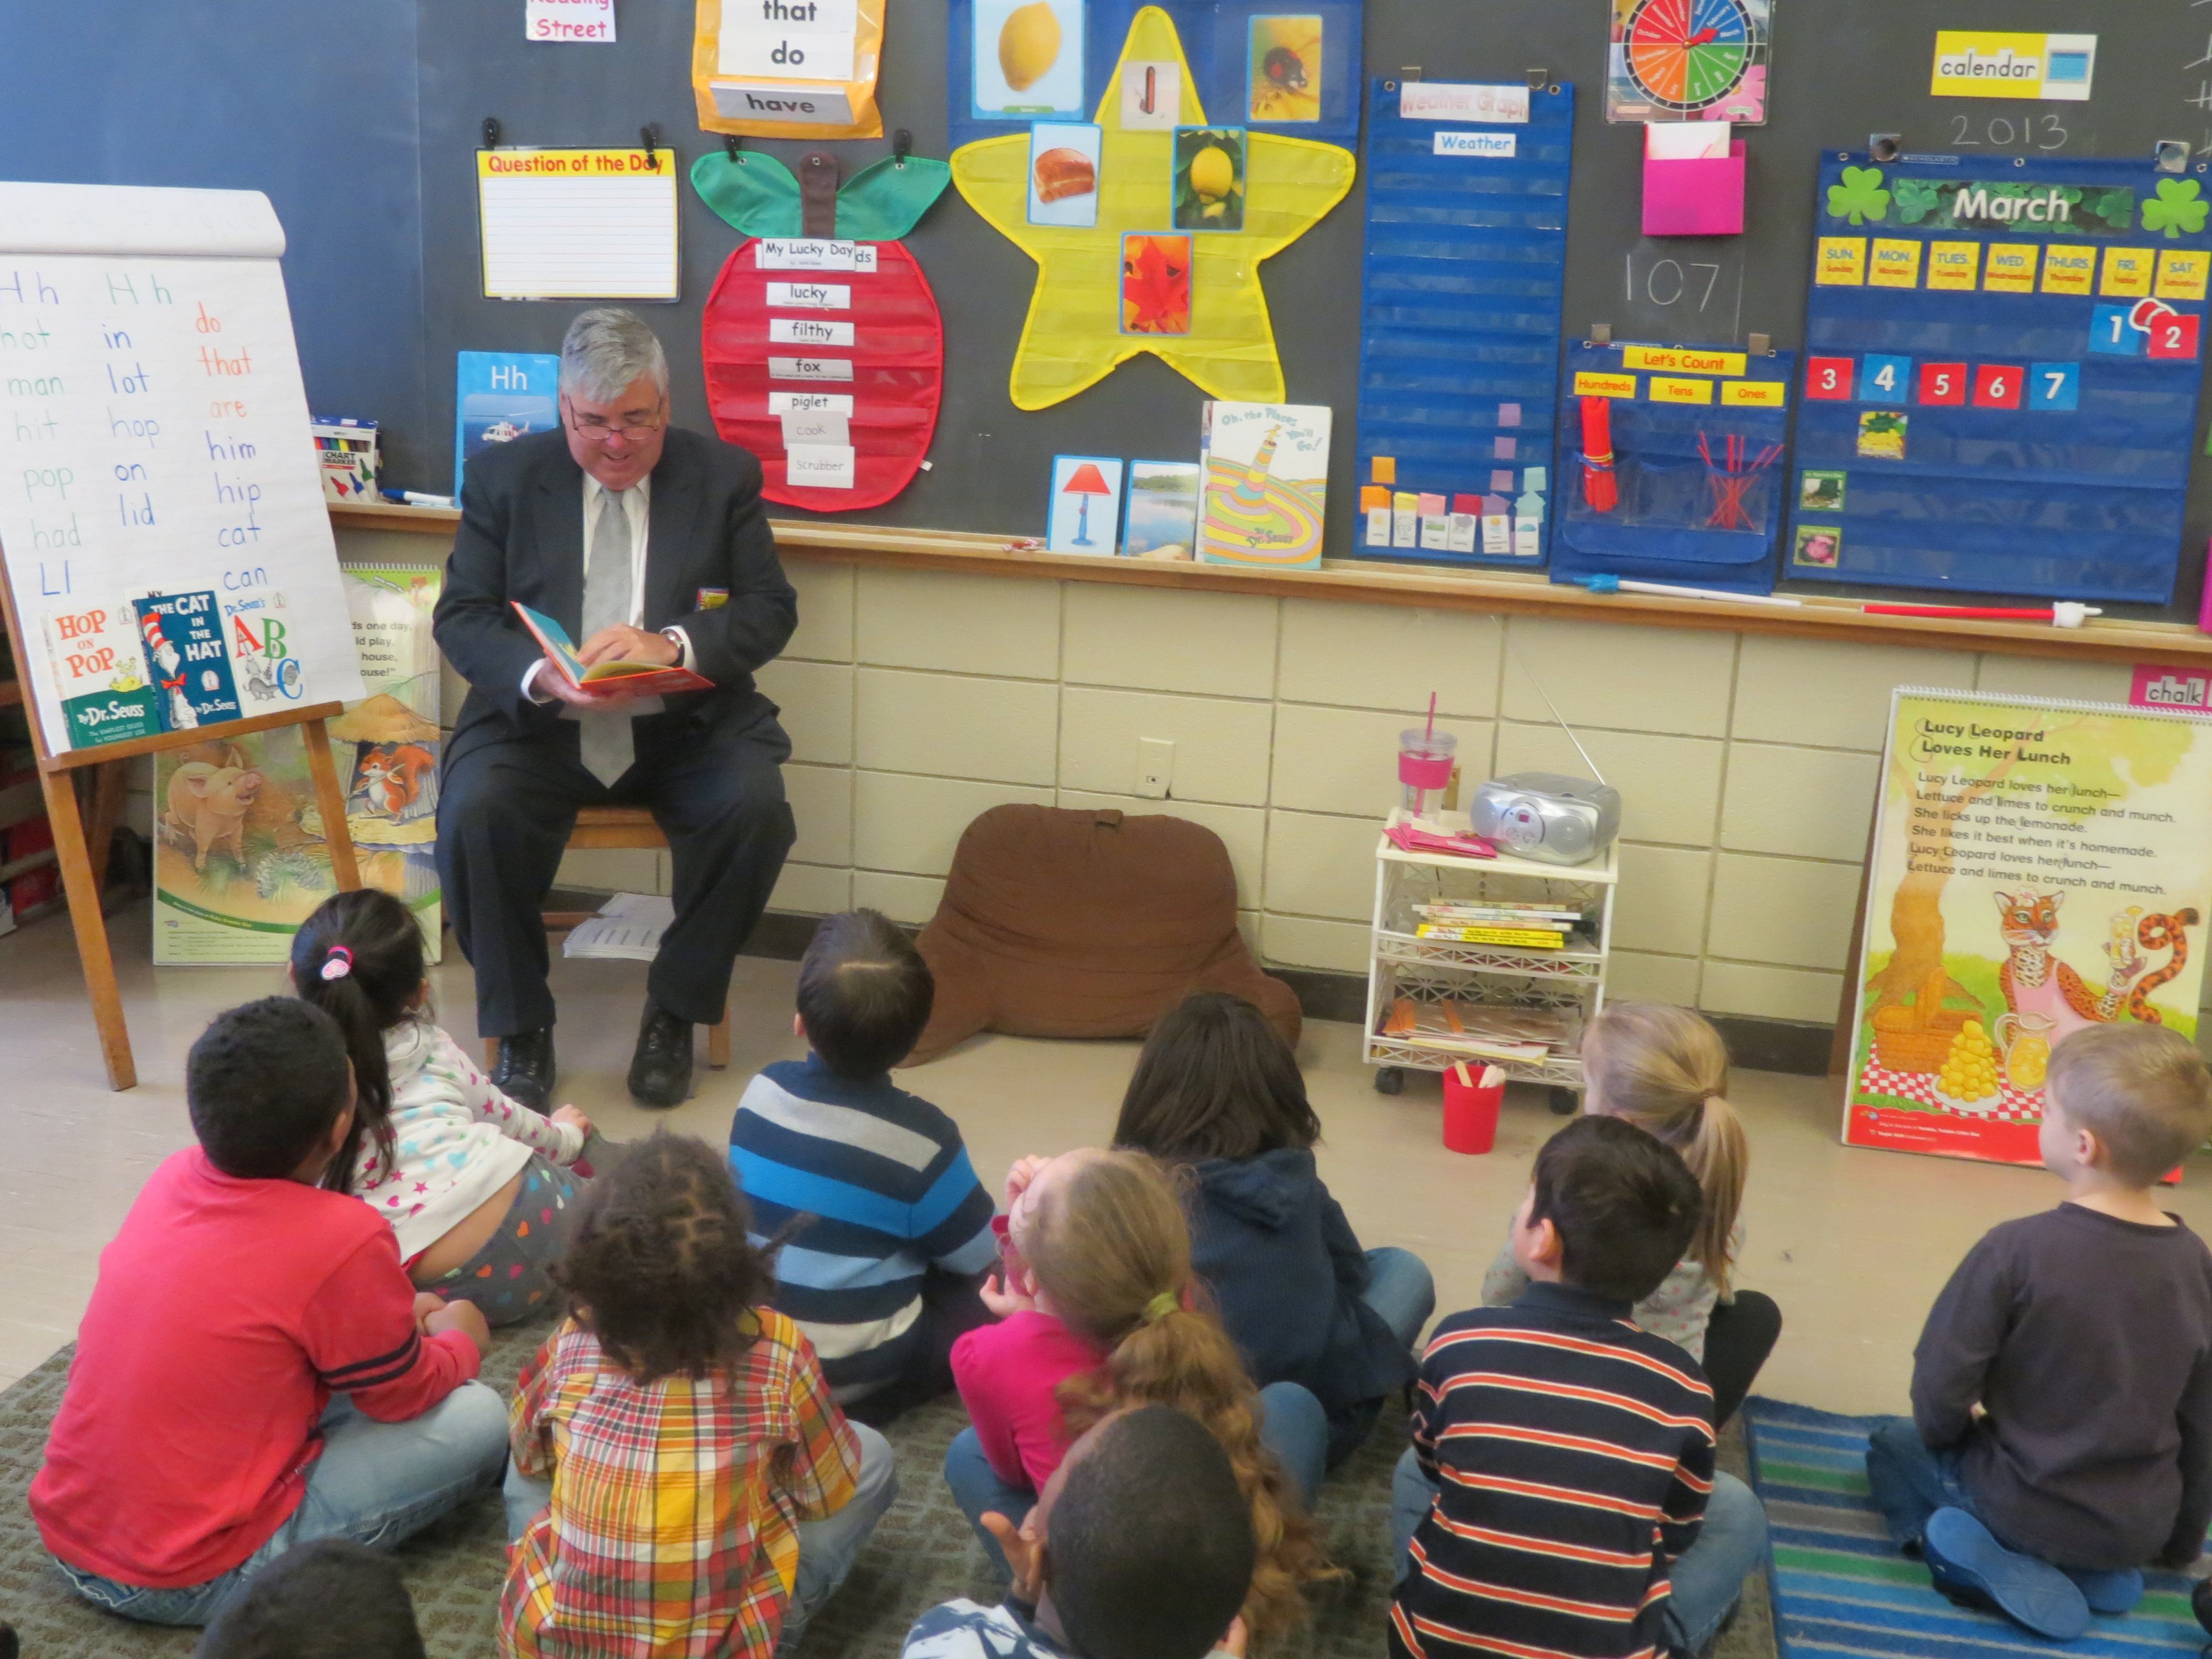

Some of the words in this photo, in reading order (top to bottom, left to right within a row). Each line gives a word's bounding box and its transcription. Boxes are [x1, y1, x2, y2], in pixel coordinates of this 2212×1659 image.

[763, 0, 817, 22] that
[535, 18, 607, 38] Street
[771, 40, 805, 65] do
[1941, 53, 2036, 79] calendar
[745, 93, 816, 113] have
[1441, 135, 1511, 150] Weather
[1950, 114, 2068, 150] 2013
[488, 155, 566, 173] Question
[571, 155, 588, 171] of
[596, 155, 624, 171] the
[1952, 188, 2070, 223] March
[766, 243, 784, 257] My
[789, 243, 824, 258] Lucky
[830, 243, 853, 258] Day
[1826, 248, 1855, 259] SUN.
[1878, 250, 1912, 262] MON.
[790, 284, 827, 303] lucky
[1626, 254, 1719, 312] 107
[196, 301, 221, 333] do
[102, 324, 132, 349] in
[792, 322, 833, 341] filthy
[2110, 316, 2123, 343] 1
[2164, 326, 2181, 348] 2
[196, 346, 252, 377] that
[795, 359, 821, 372] fox
[1644, 352, 1676, 367] Let's
[1682, 355, 1725, 370] Count
[9, 375, 65, 396] man
[107, 362, 149, 394] lot
[492, 365, 527, 390] Hh
[1578, 378, 1632, 392] Hundreds
[1822, 368, 1837, 390] 3
[1874, 364, 1896, 392] 4
[1934, 373, 1949, 395] 5
[1989, 376, 2005, 398] 6
[2044, 373, 2065, 400] 7
[791, 395, 828, 410] piglet
[1668, 385, 1693, 397] Tens
[1738, 388, 1767, 399] Ones
[210, 400, 247, 418] are
[15, 408, 58, 441] hit
[107, 406, 160, 448] hop
[796, 423, 827, 435] cook
[206, 430, 256, 461] him
[326, 451, 356, 460] CHART
[115, 463, 147, 481] on
[23, 467, 74, 502] pop
[215, 471, 260, 514] hip
[120, 493, 155, 526] lid
[31, 512, 81, 549] had
[218, 514, 261, 547] cat
[223, 566, 268, 590] can
[150, 603, 175, 615] THE
[175, 594, 210, 615] CAT
[55, 610, 107, 640] HOP
[191, 617, 205, 627] IN
[77, 639, 94, 650] ON
[189, 629, 211, 639] THE
[185, 640, 222, 661] HAT
[65, 647, 114, 678] POP
[2150, 681, 2201, 704] chalk
[85, 707, 109, 726] Dr.
[108, 701, 145, 719] Seuss
[214, 699, 236, 711] Seuss
[1924, 719, 1965, 737] Lucy
[1971, 723, 2044, 742] Leopard
[1922, 740, 1973, 757] Loves
[1979, 745, 2010, 759] Her
[2017, 747, 2071, 765] Lunch
[1918, 772, 1948, 785] Lucy
[1952, 775, 2004, 789] Leopard
[2010, 780, 2042, 792] loves
[2047, 784, 2068, 794] her
[1917, 790, 1963, 803] Lettuce
[1969, 796, 1992, 806] and
[1996, 797, 2030, 810] limes
[2036, 801, 2048, 811] to
[2052, 804, 2096, 816] crunch
[2100, 808, 2125, 818] and
[2129, 811, 2176, 823] munch.
[1914, 807, 1938, 819] She
[1943, 810, 1970, 822] licks
[1975, 816, 1990, 826] up
[1995, 815, 2016, 826] the
[2020, 816, 2088, 833] lemonade.
[1912, 826, 1936, 836] She
[1940, 828, 1969, 839] likes
[1974, 831, 1982, 841] it
[1986, 832, 2014, 844] best
[2018, 836, 2052, 847] when
[2057, 838, 2075, 850] it's
[2081, 841, 2157, 857] homemade.
[1910, 842, 1938, 857] Lucy
[1943, 847, 1996, 860] Leopard
[2001, 852, 2033, 864] loves
[2038, 855, 2058, 866] her
[1908, 859, 1955, 874] Lettuce
[1960, 868, 1984, 877] and
[1988, 868, 2022, 880] limes
[2027, 872, 2039, 883] to
[2043, 875, 2086, 886] crunch
[2090, 880, 2115, 890] and
[2119, 883, 2166, 895] munch.
